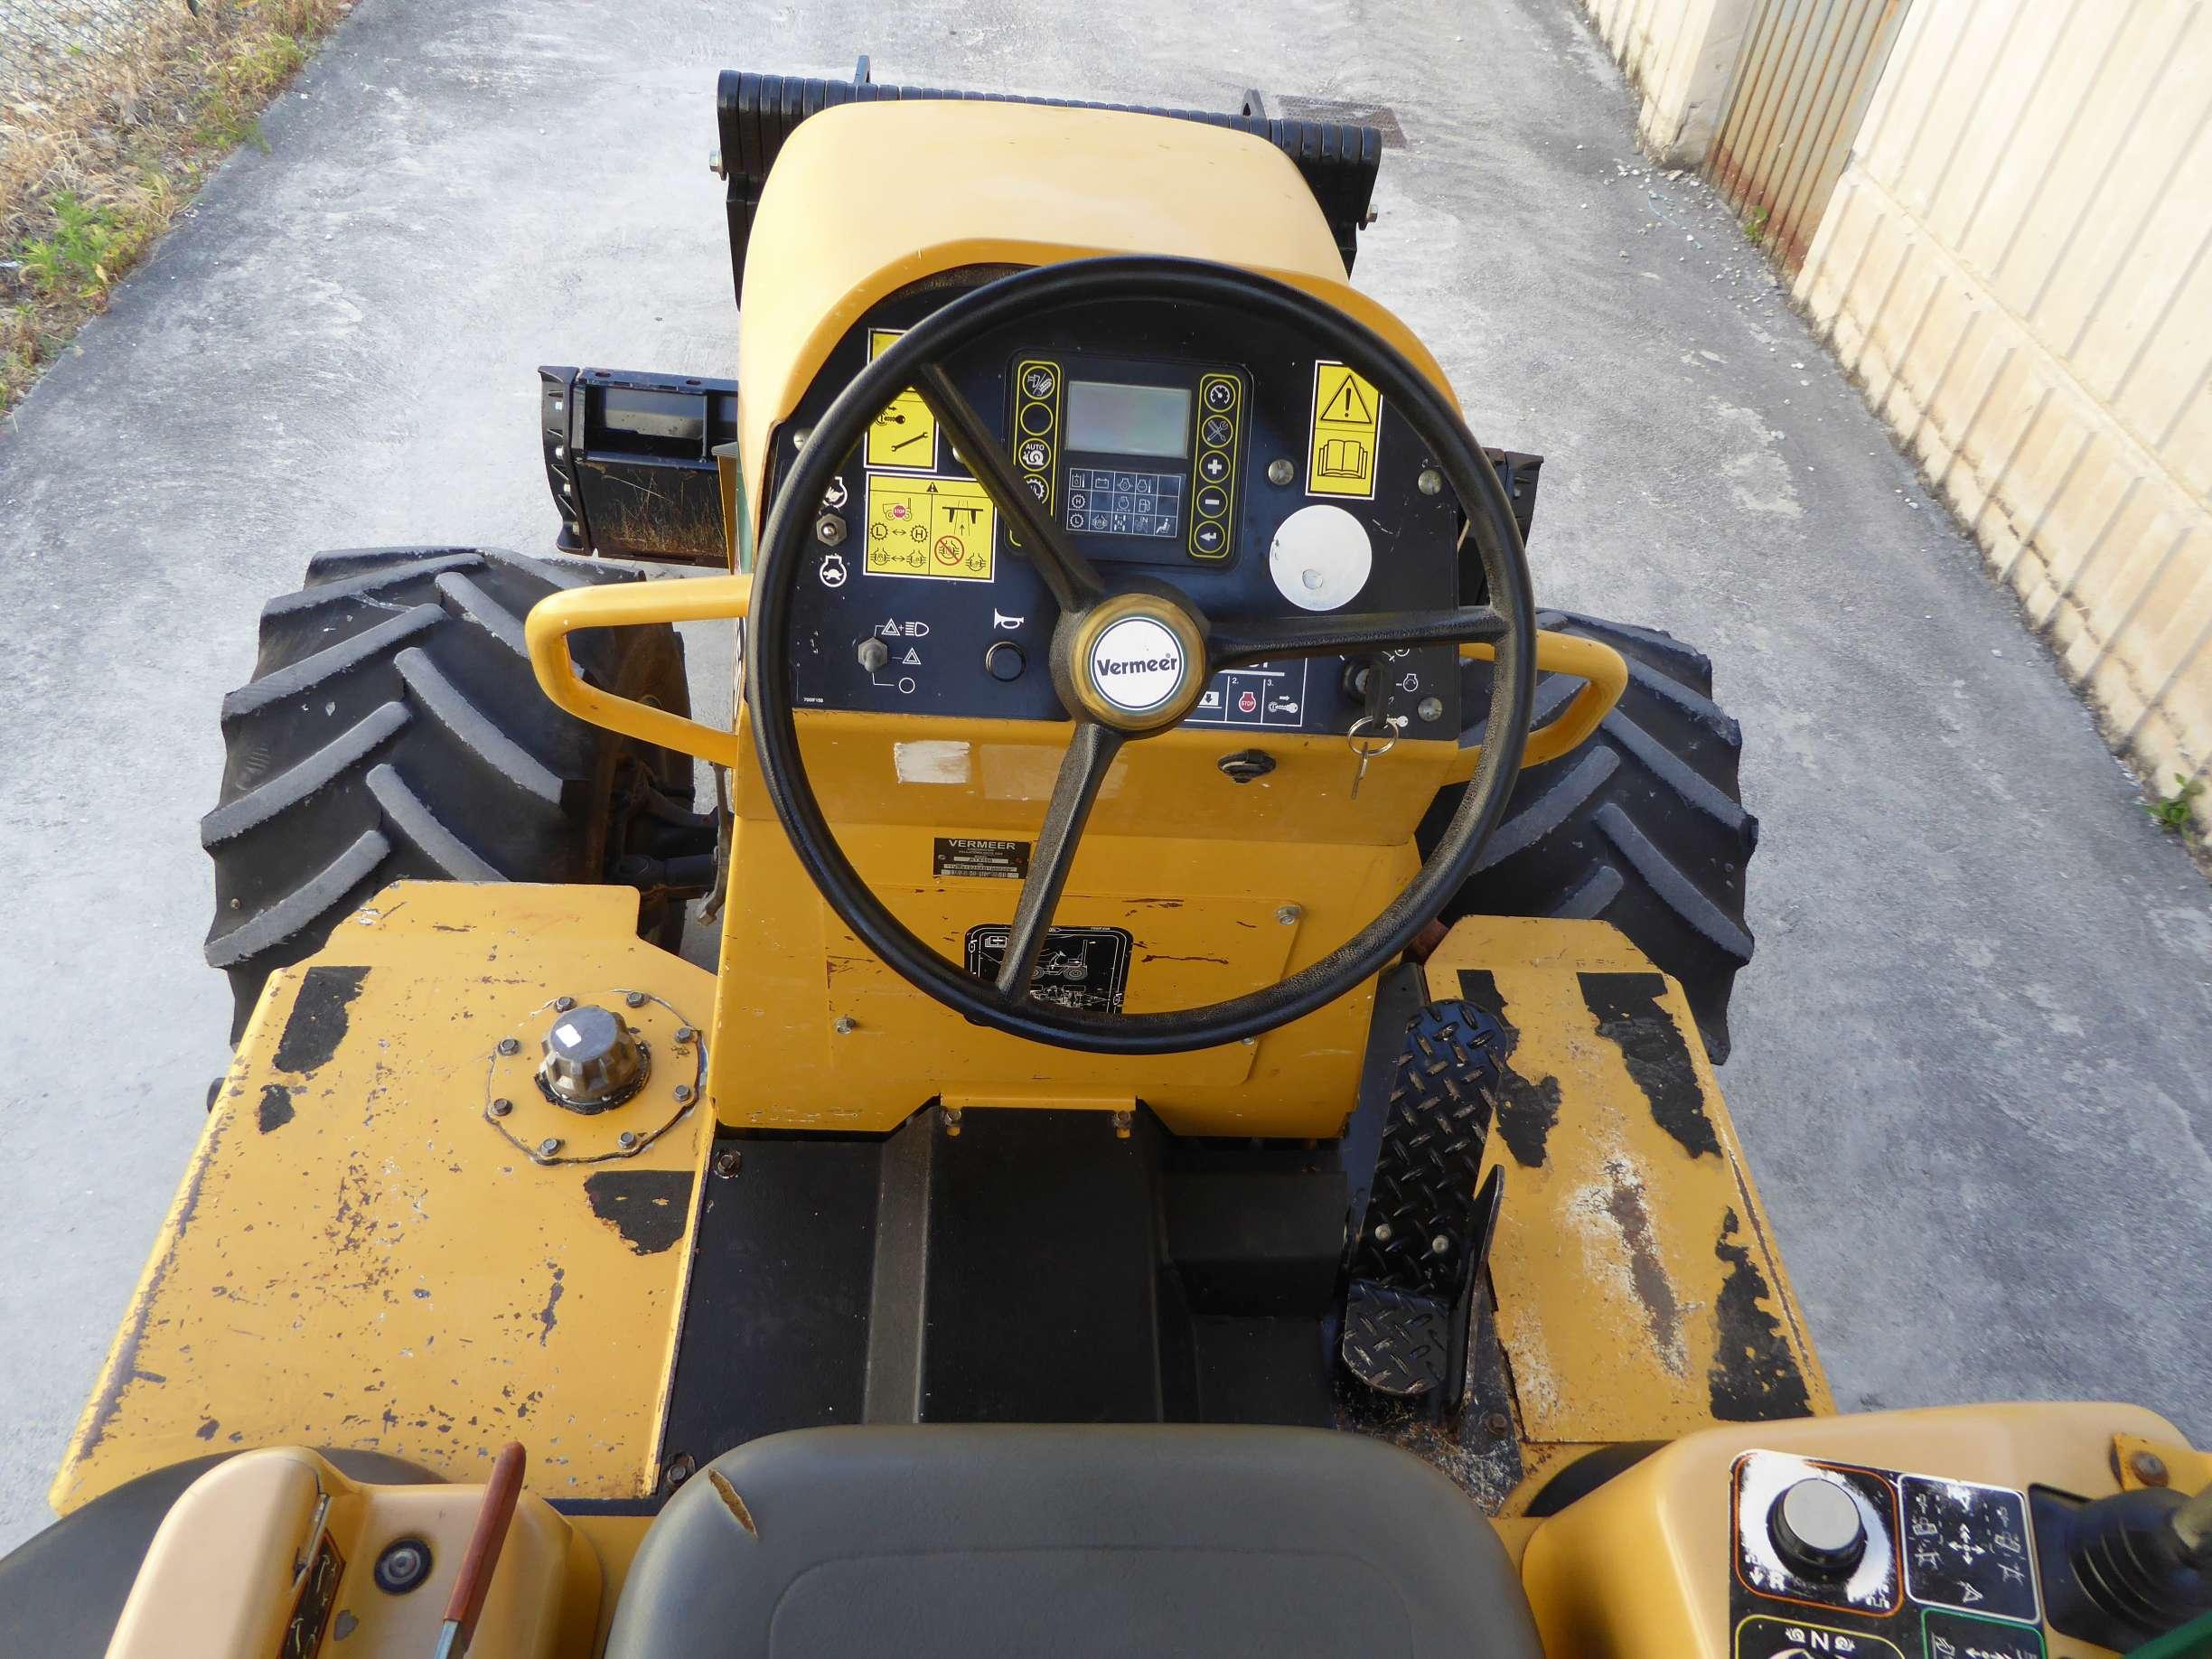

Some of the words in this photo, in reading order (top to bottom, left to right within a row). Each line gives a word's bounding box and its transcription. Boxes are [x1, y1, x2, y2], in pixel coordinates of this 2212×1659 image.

[876, 527, 883, 537] L
[915, 530, 923, 539] H
[1097, 658, 1177, 676] Vermeer
[948, 839, 1017, 849] VERMEER
[1811, 1629, 1830, 1652] N
